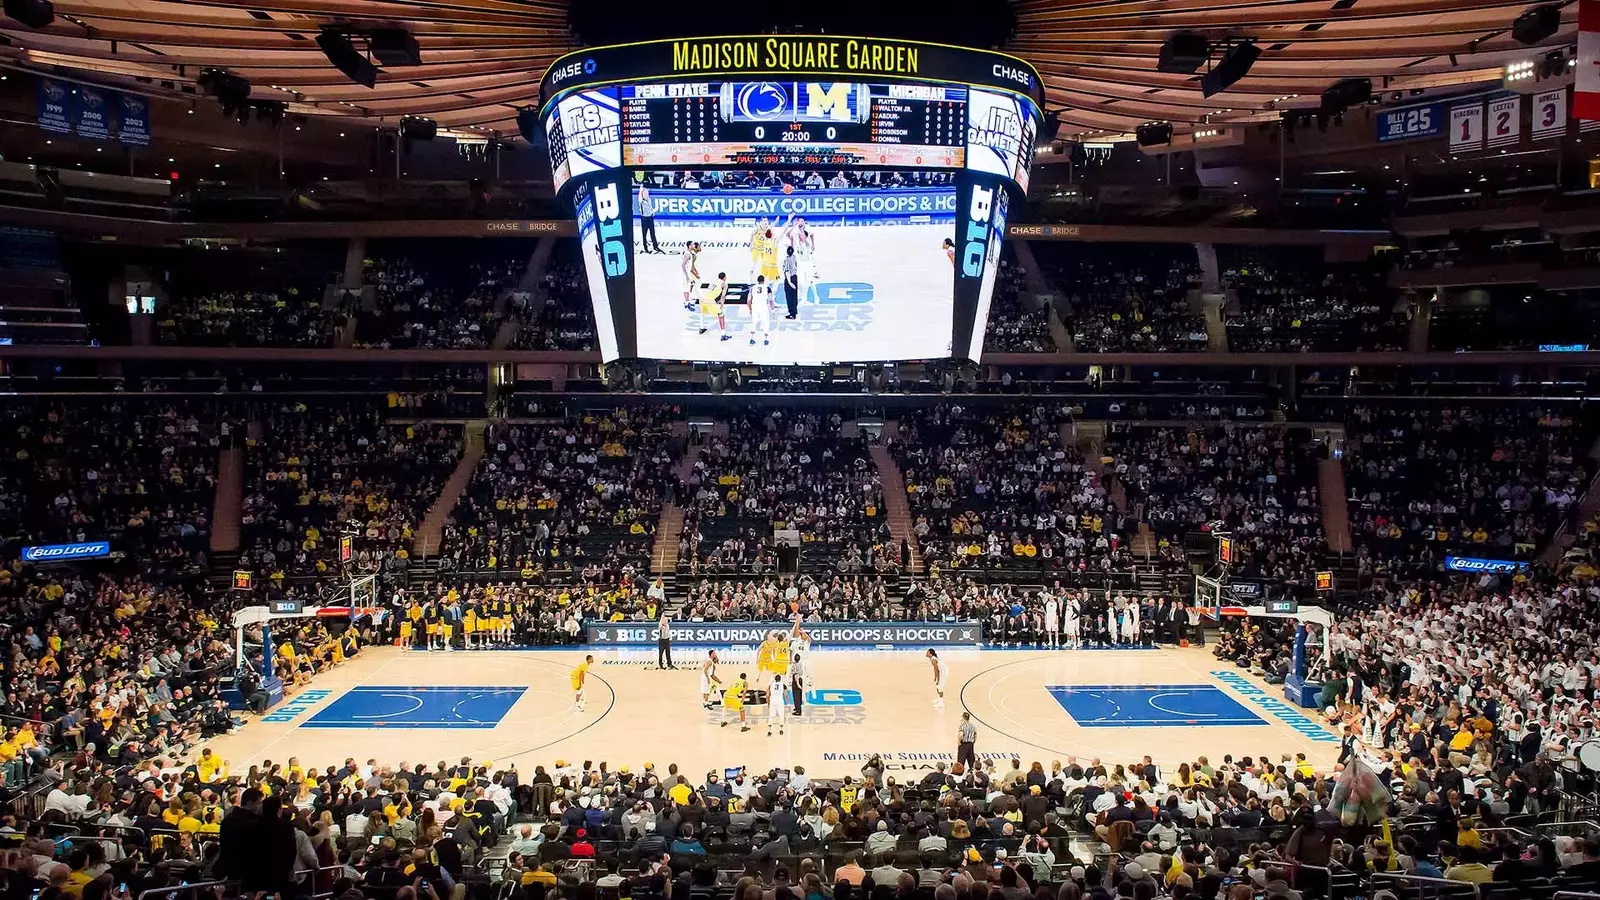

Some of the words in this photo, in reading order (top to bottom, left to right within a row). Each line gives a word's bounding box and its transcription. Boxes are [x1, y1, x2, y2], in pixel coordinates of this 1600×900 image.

[673, 42, 758, 70] MADISON
[765, 38, 839, 68] SQUARE
[846, 40, 918, 73] GARDEN
[552, 62, 582, 84] CHASE
[992, 64, 1029, 86] CHASE
[668, 83, 708, 96] STATE
[1388, 112, 1405, 124] BILLY
[1407, 108, 1431, 132] 25
[1497, 112, 1510, 135] 2
[1542, 103, 1556, 127] 3
[755, 127, 764, 139] 0
[782, 132, 810, 141] 20:00
[826, 127, 836, 139] 0
[1461, 119, 1470, 141] 1
[650, 198, 689, 213] UPER
[692, 198, 779, 213] SATURDAY
[780, 197, 855, 212] COLLEGE
[859, 196, 917, 212] HOOPS
[919, 196, 932, 210] &
[32, 548, 62, 557] BUD
[63, 546, 104, 554] LIGHT
[1456, 560, 1485, 568] BUD
[651, 629, 694, 641] SPER
[697, 629, 766, 640] SATURDAY
[832, 629, 882, 640] HOOPS
[883, 629, 894, 640] &
[896, 629, 953, 640] HOCKEY
[260, 707, 307, 723] BIG
[287, 689, 334, 705] TEN
[1209, 671, 1265, 695] SUPER
[1249, 696, 1342, 742] SATURDAY
[823, 753, 892, 761] MADISN
